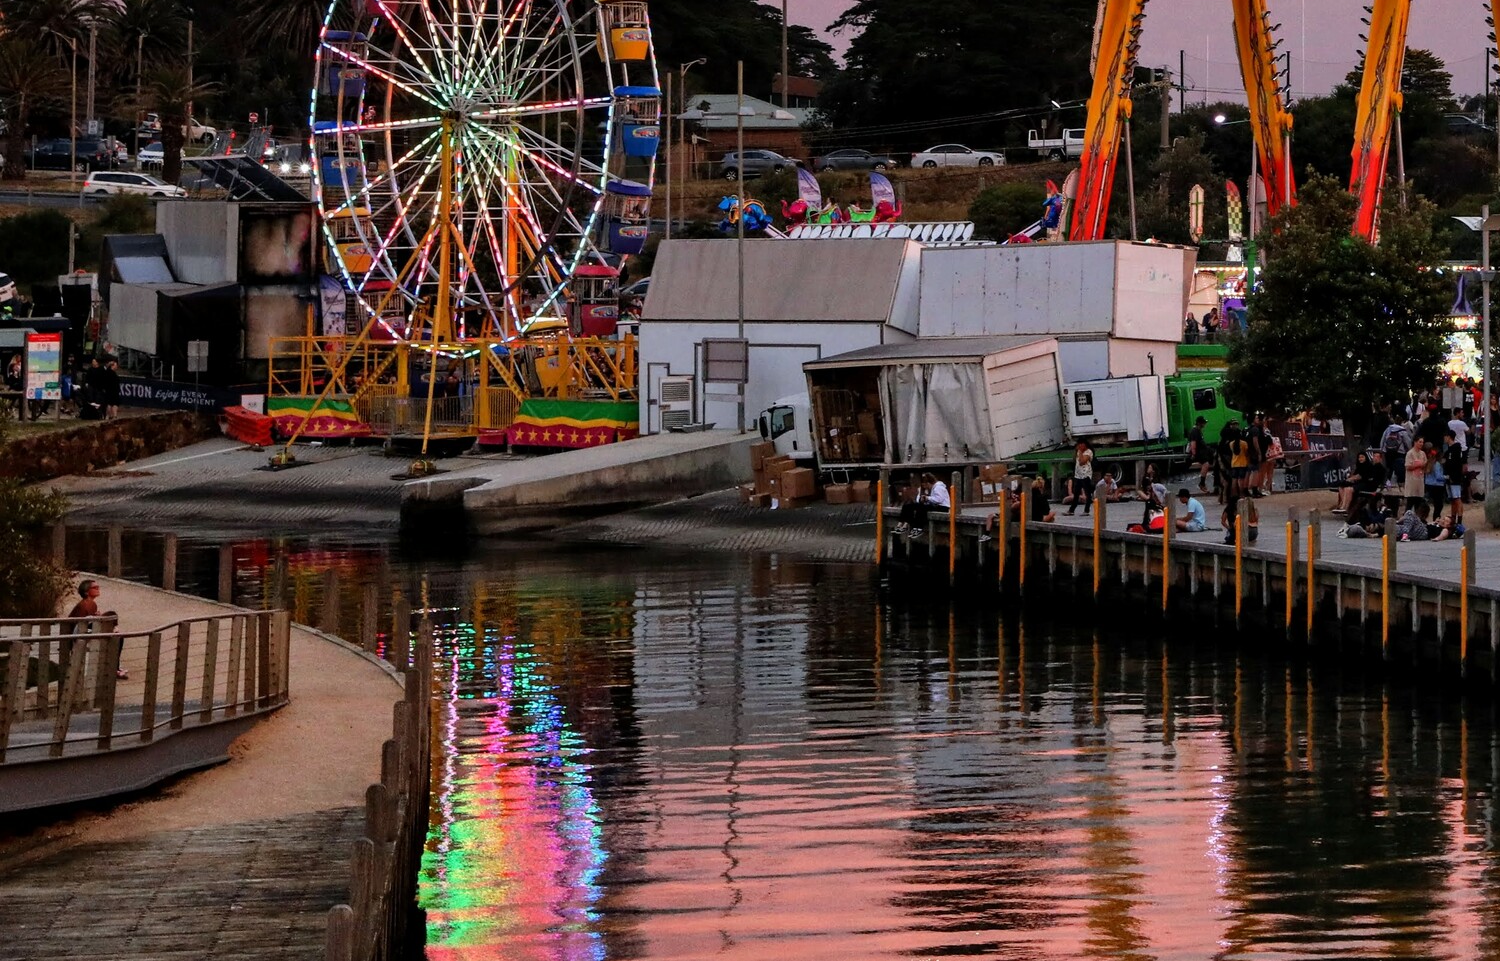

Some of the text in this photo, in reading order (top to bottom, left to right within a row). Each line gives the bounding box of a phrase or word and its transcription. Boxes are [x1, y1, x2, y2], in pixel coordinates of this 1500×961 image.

[155, 389, 179, 402] Enjoy
[181, 390, 207, 400] EVERY
[181, 397, 216, 407] MOMENT
